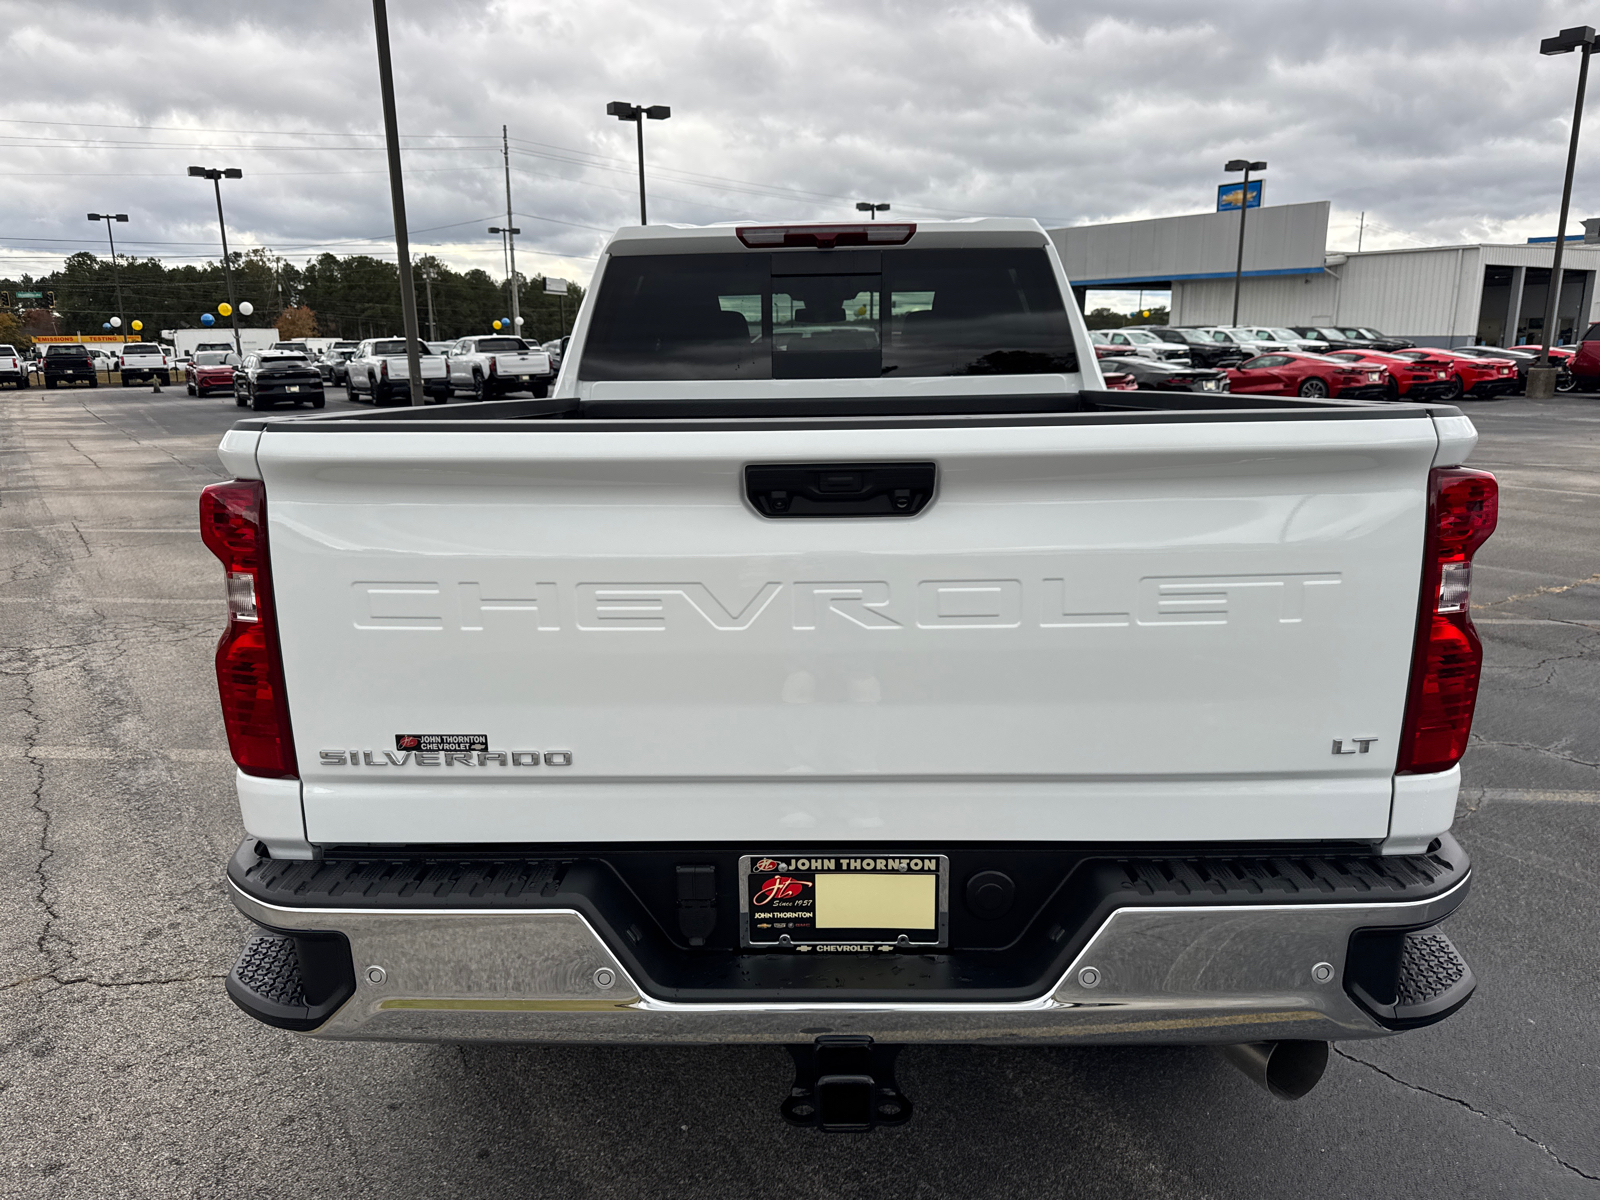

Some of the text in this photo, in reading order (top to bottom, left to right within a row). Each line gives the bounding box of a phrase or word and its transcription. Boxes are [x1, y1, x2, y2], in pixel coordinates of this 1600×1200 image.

[351, 572, 1342, 632] CHEVROLET
[421, 735, 485, 743] JOHN THORNTON
[1332, 737, 1378, 754] LT
[319, 750, 572, 767] SILVERADO
[789, 859, 936, 870] JOHN THORNTON
